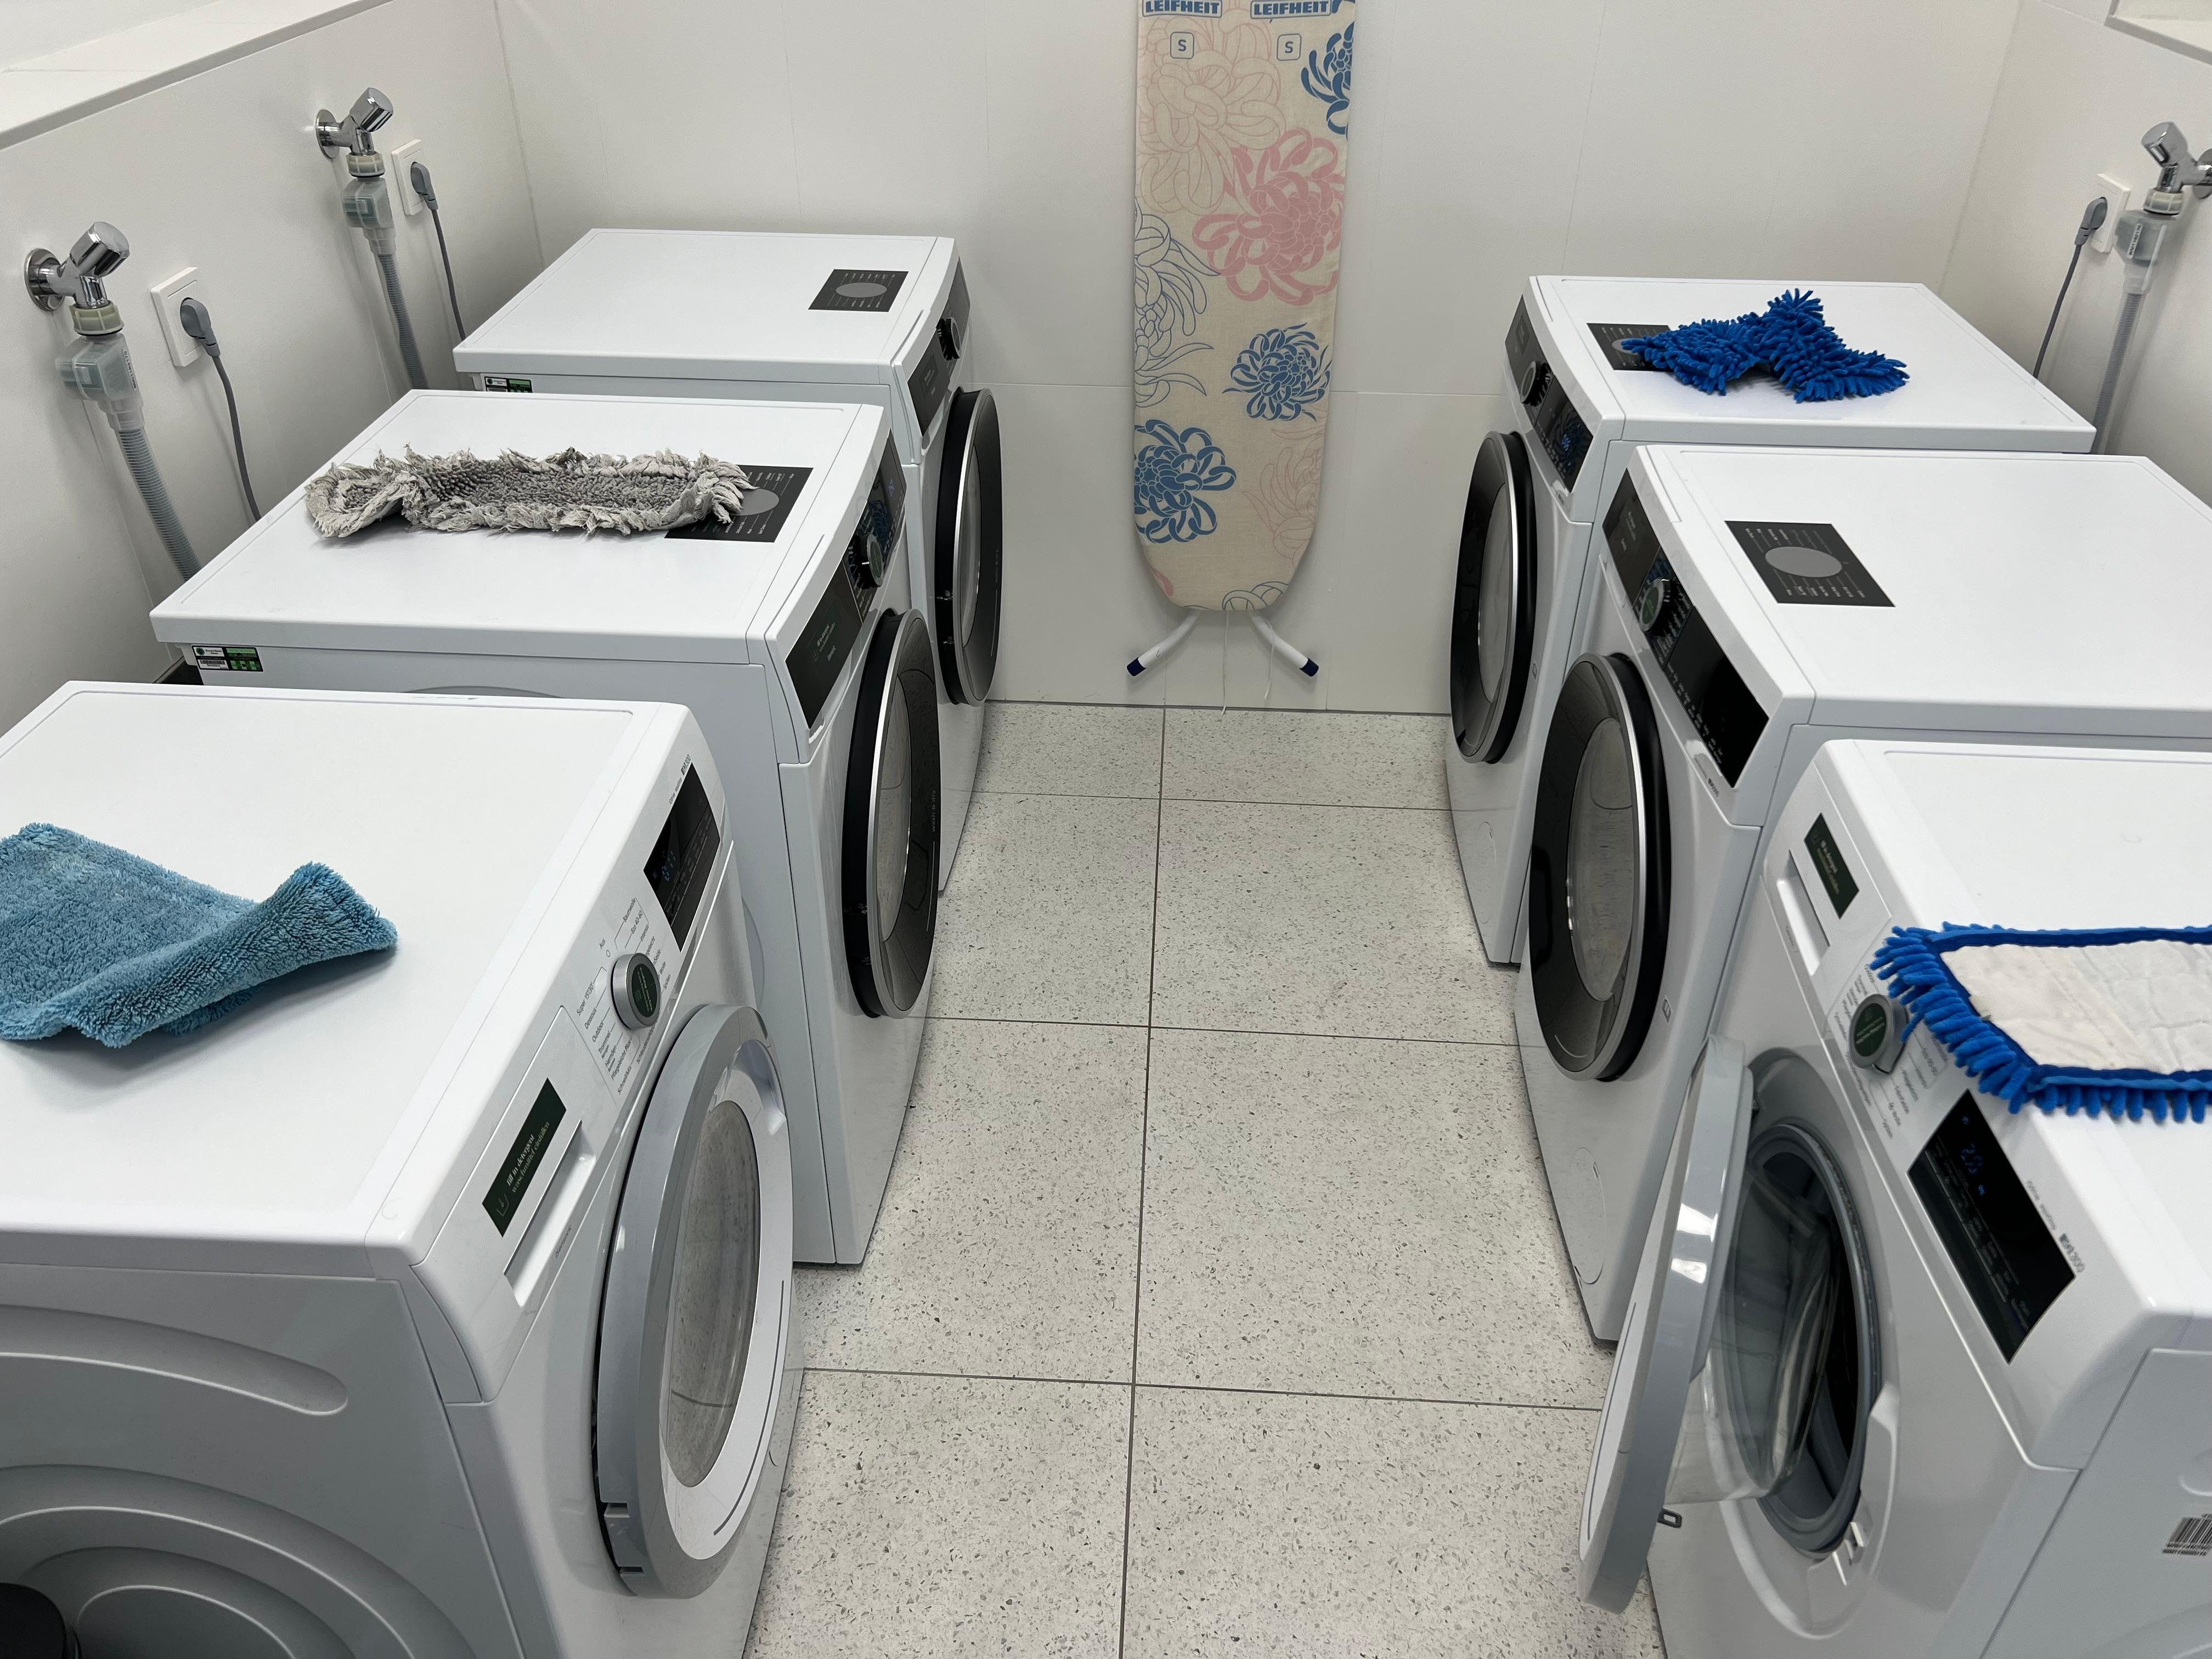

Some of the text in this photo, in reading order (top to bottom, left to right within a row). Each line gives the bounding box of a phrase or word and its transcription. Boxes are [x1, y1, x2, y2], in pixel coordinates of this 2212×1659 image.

[1146, 0, 1219, 14] LEIFHEIT
[1254, 1, 1328, 15] LEIFHEIT
[1178, 39, 1187, 52] S
[1284, 41, 1294, 54] S
[576, 999, 585, 1016] Super
[584, 1007, 596, 1030] Dessous
[592, 1020, 604, 1042] Outdoor
[598, 1030, 611, 1054] Trommel
[605, 1045, 617, 1068] Hemden
[611, 1050, 626, 1081] Pflegeleicht
[511, 1167, 518, 1176] in
